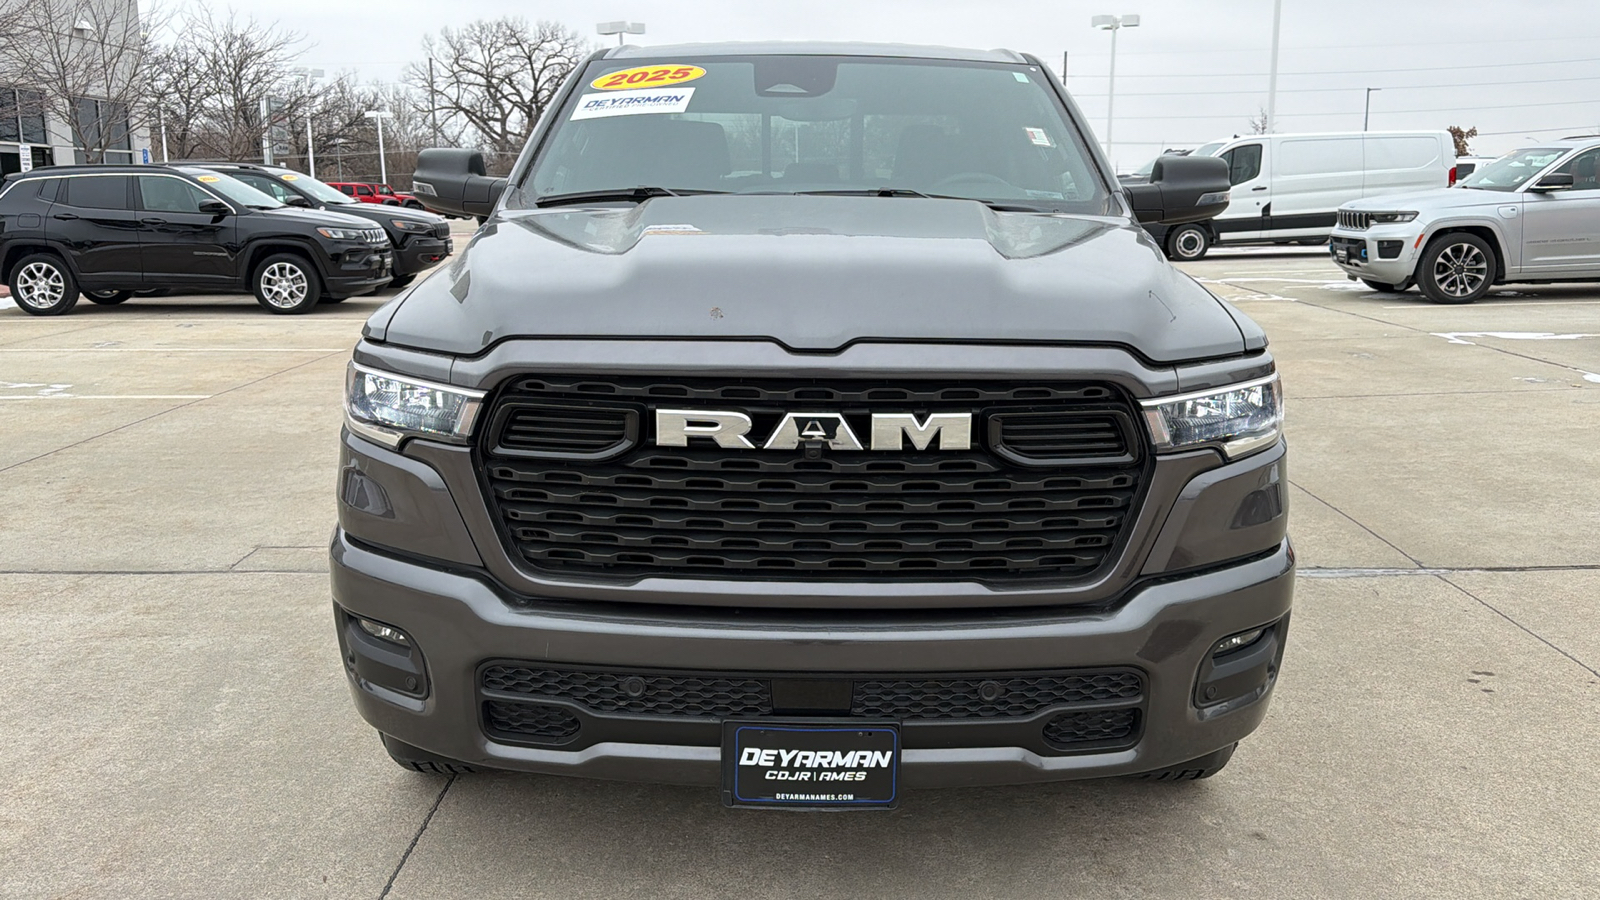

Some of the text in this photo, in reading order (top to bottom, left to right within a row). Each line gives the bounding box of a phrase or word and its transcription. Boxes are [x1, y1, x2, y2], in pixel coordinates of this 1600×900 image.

[602, 67, 694, 87] 2025
[584, 95, 685, 109] DEYARMAN
[588, 103, 630, 112] CERTIFIED
[656, 408, 972, 450] RAM
[739, 747, 892, 768] DEYARMAN
[765, 770, 811, 781] CDJR
[819, 771, 867, 781] AMES
[775, 793, 854, 801] DEYARMANAMES.COM
